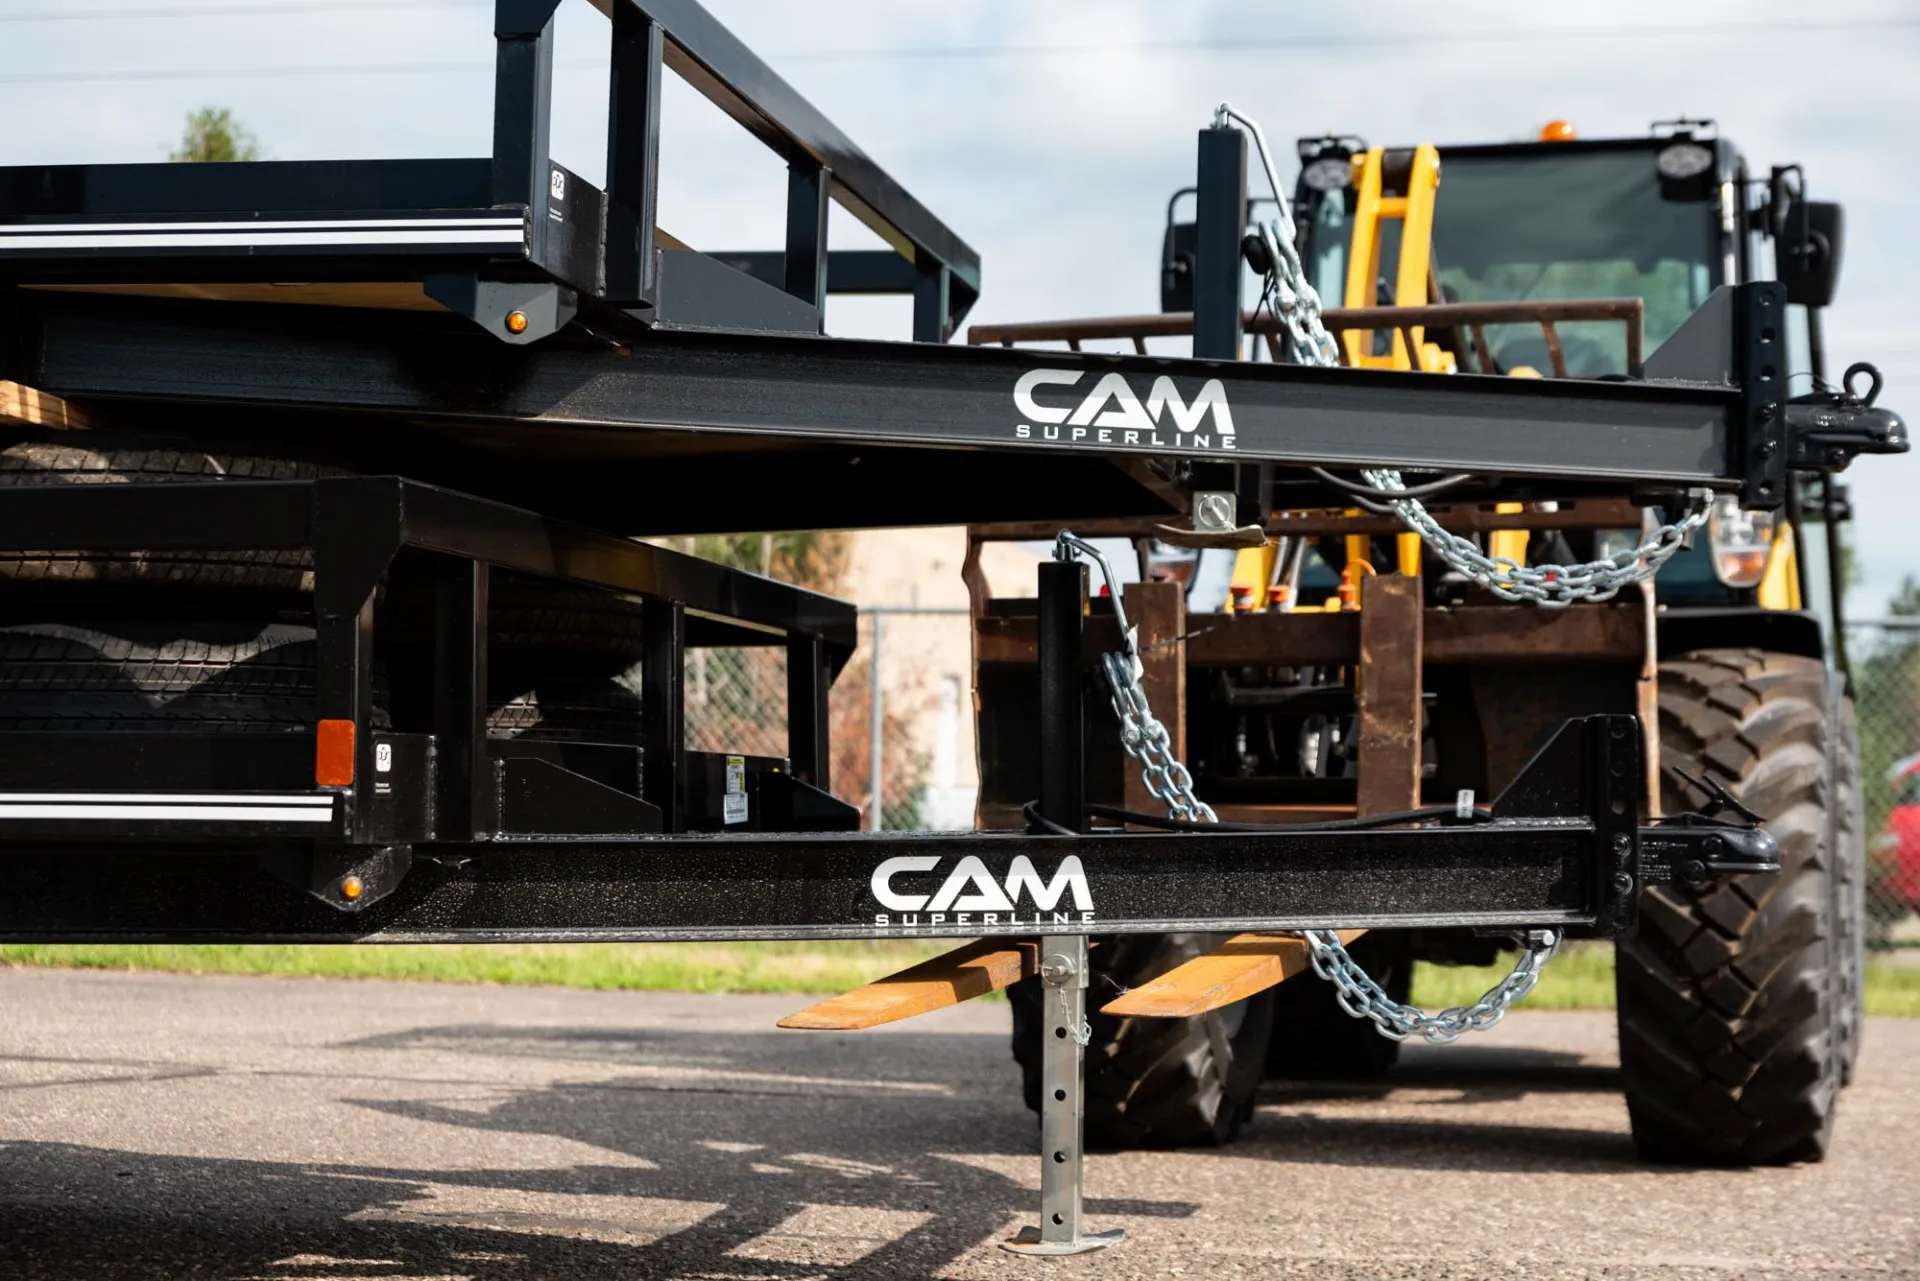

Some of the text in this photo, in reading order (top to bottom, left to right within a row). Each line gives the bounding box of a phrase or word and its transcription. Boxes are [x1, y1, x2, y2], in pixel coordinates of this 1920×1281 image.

[1013, 368, 1236, 435] CAM
[1016, 424, 1237, 449] SUPERLINE
[870, 854, 1095, 911] CAM
[875, 912, 1096, 927] SUPERLINE
